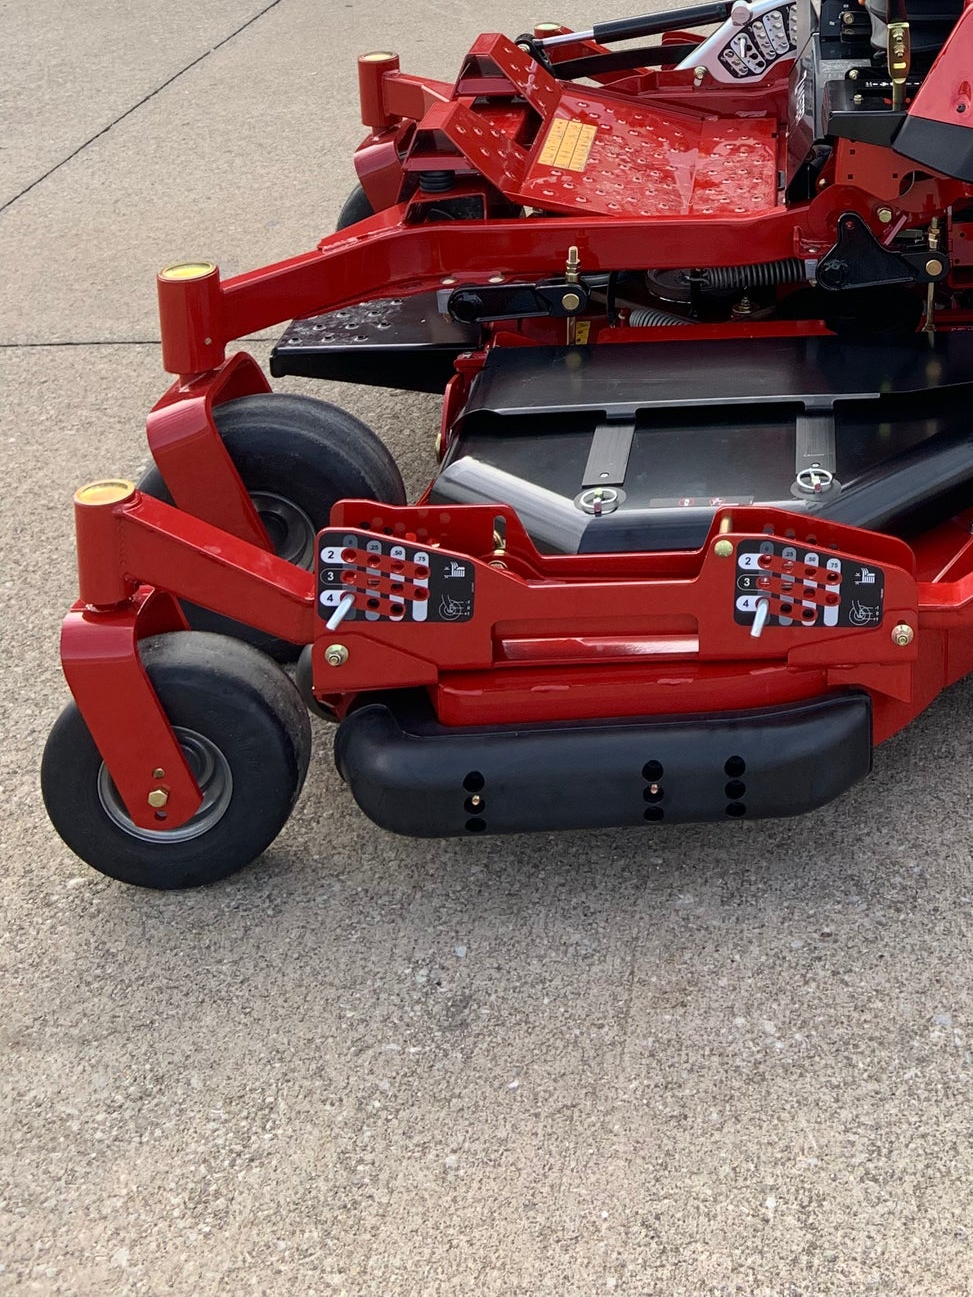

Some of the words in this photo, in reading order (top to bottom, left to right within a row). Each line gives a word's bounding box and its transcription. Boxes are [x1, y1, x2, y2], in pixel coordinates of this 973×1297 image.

[327, 550, 335, 559] 2
[745, 557, 752, 565] 2
[327, 572, 335, 581] 3
[743, 578, 751, 587] 3
[326, 594, 334, 602] 4
[742, 600, 750, 608] 4
